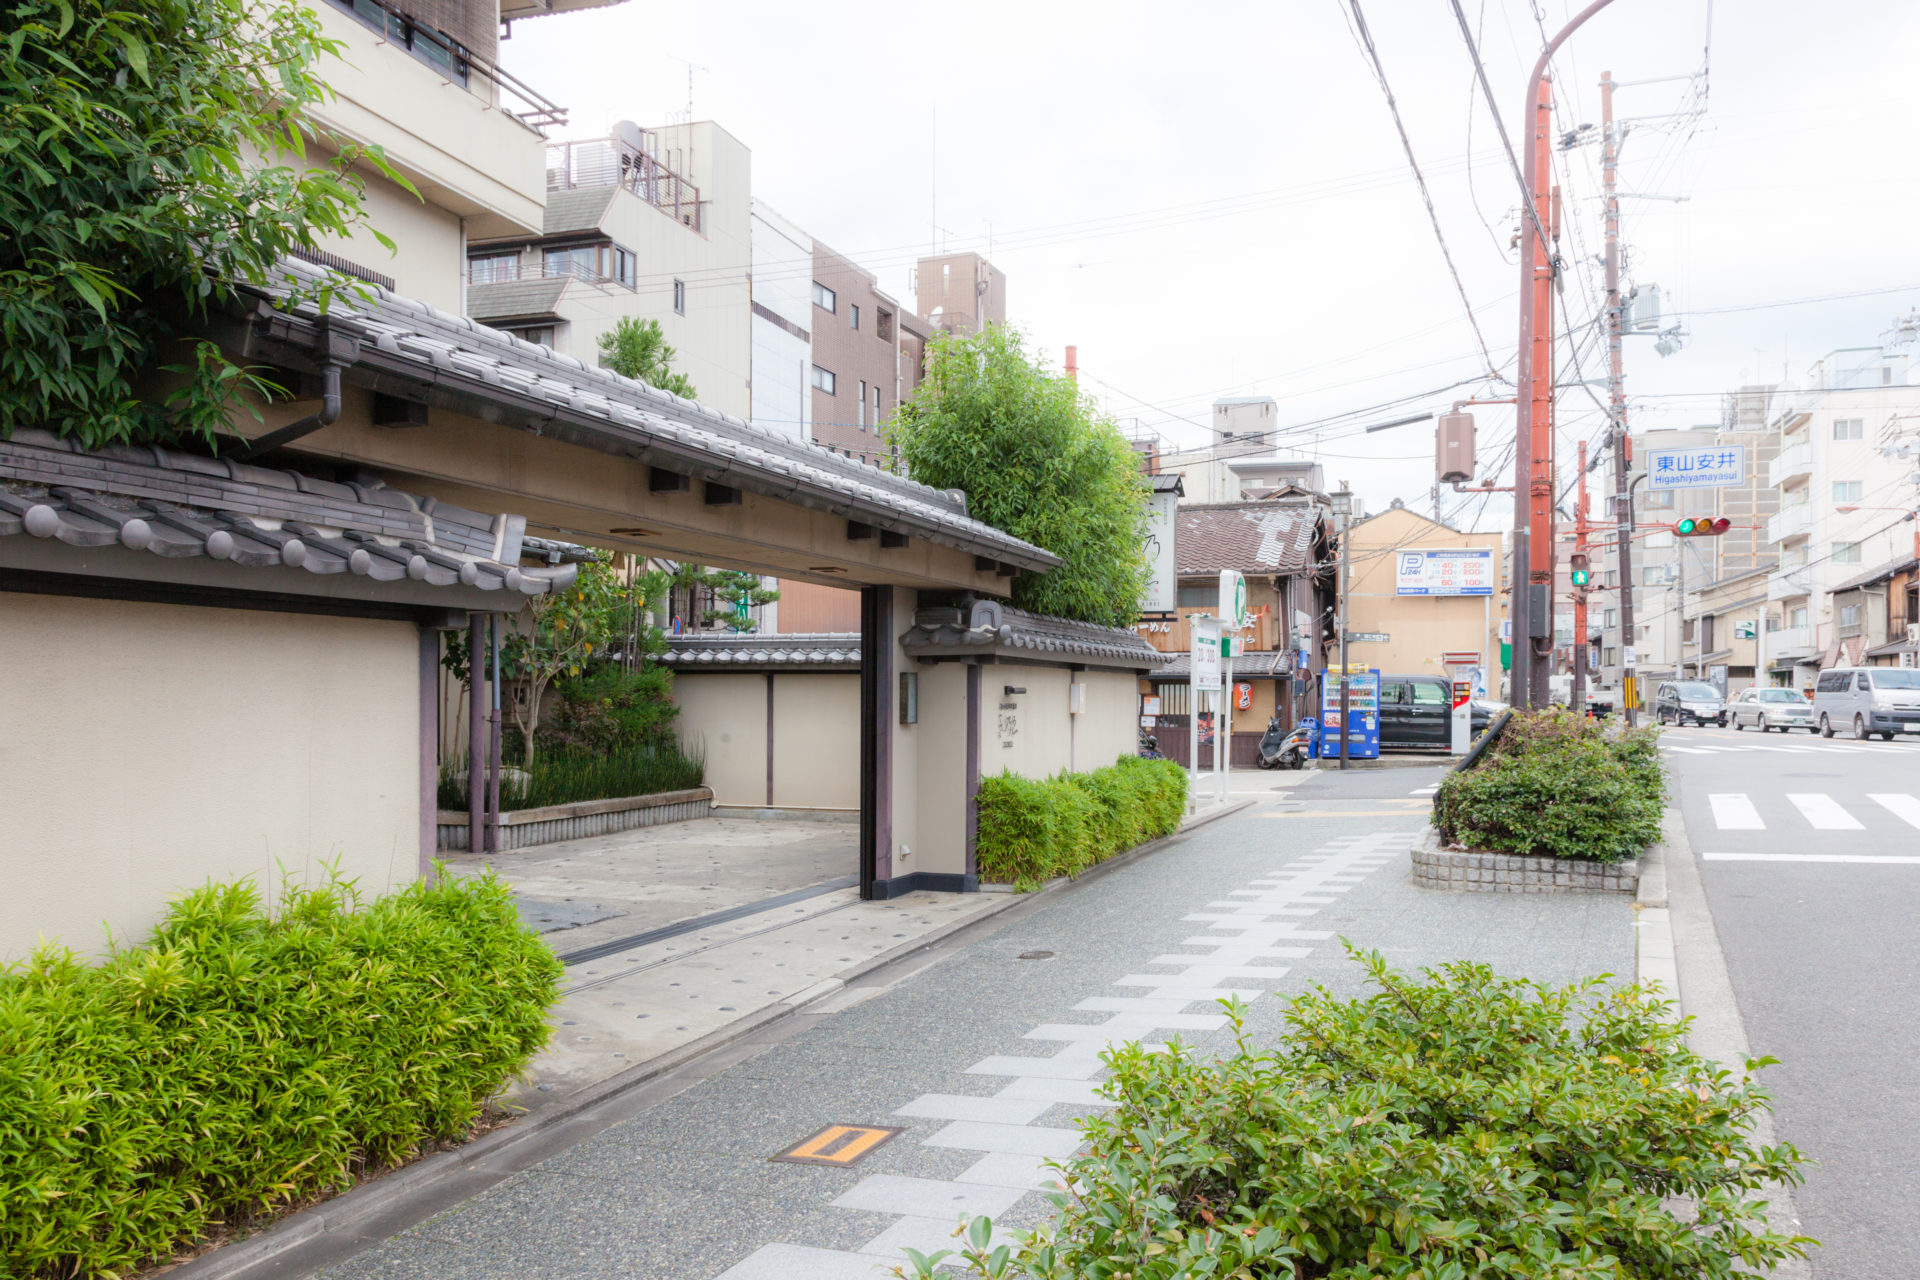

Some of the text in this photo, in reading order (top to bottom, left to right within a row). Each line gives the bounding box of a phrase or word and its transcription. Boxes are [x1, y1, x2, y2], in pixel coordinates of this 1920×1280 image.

[1656, 452, 1736, 473] 東山安井
[1655, 471, 1737, 485] Higashiyamayasui
